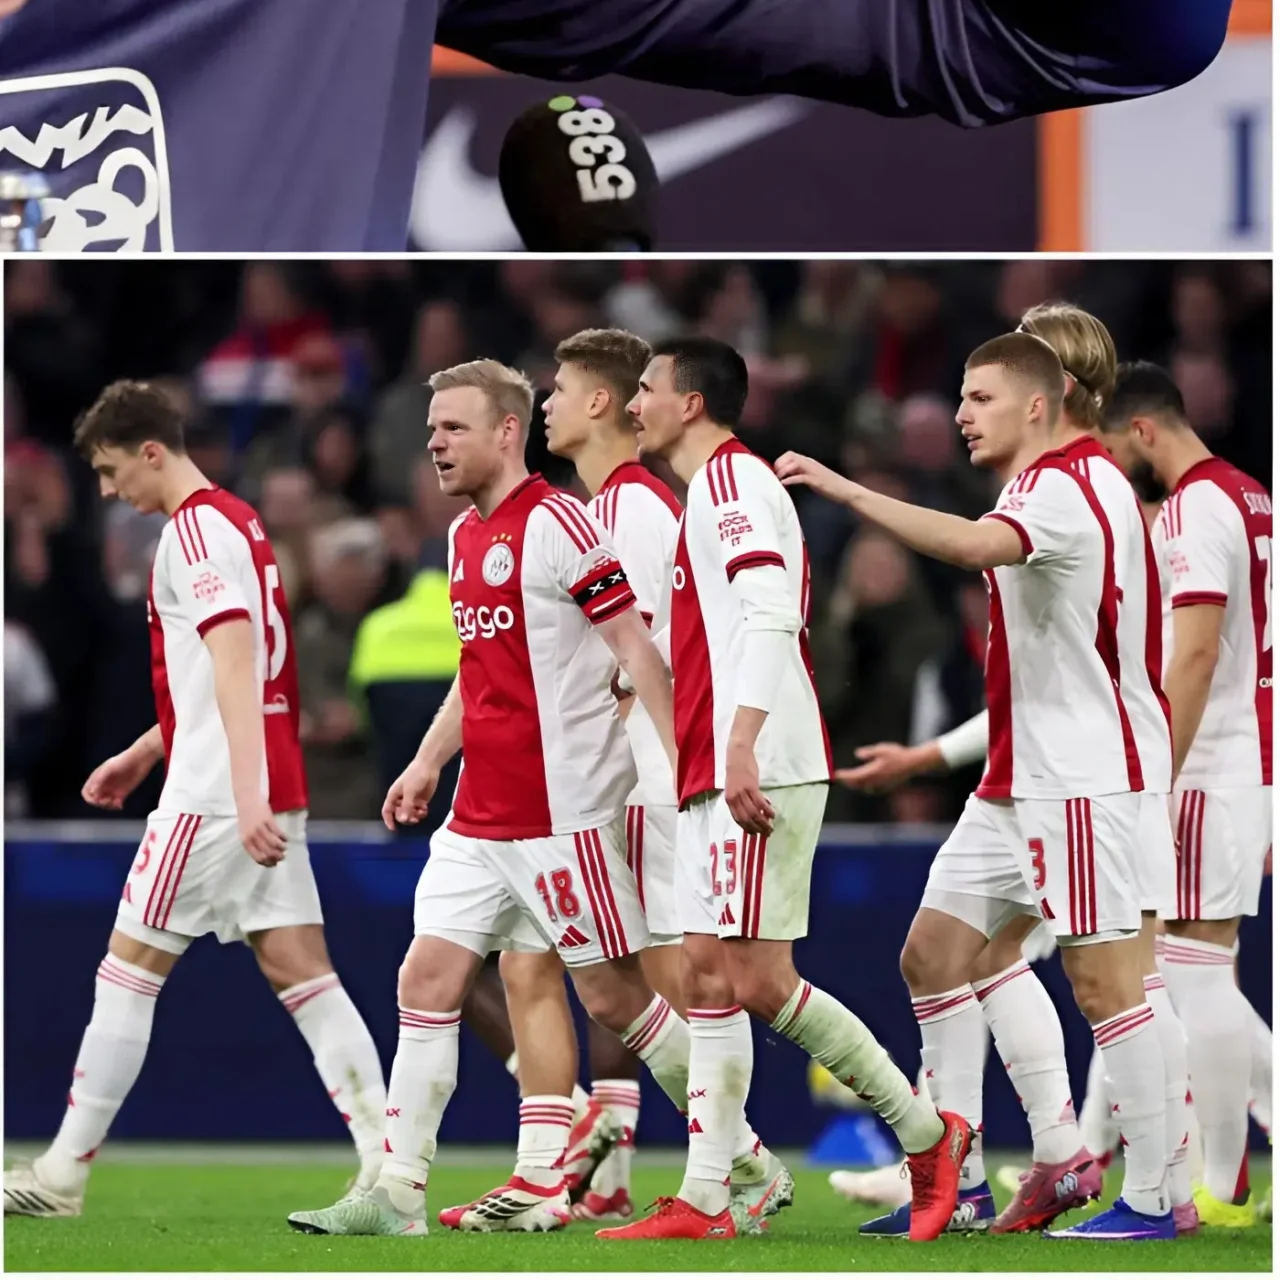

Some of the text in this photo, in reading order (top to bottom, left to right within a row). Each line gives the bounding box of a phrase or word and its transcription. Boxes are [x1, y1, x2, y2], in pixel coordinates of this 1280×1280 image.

[557, 108, 637, 203] 538
[709, 839, 738, 897] 23
[1027, 837, 1048, 891] 3
[535, 866, 582, 923] 18
